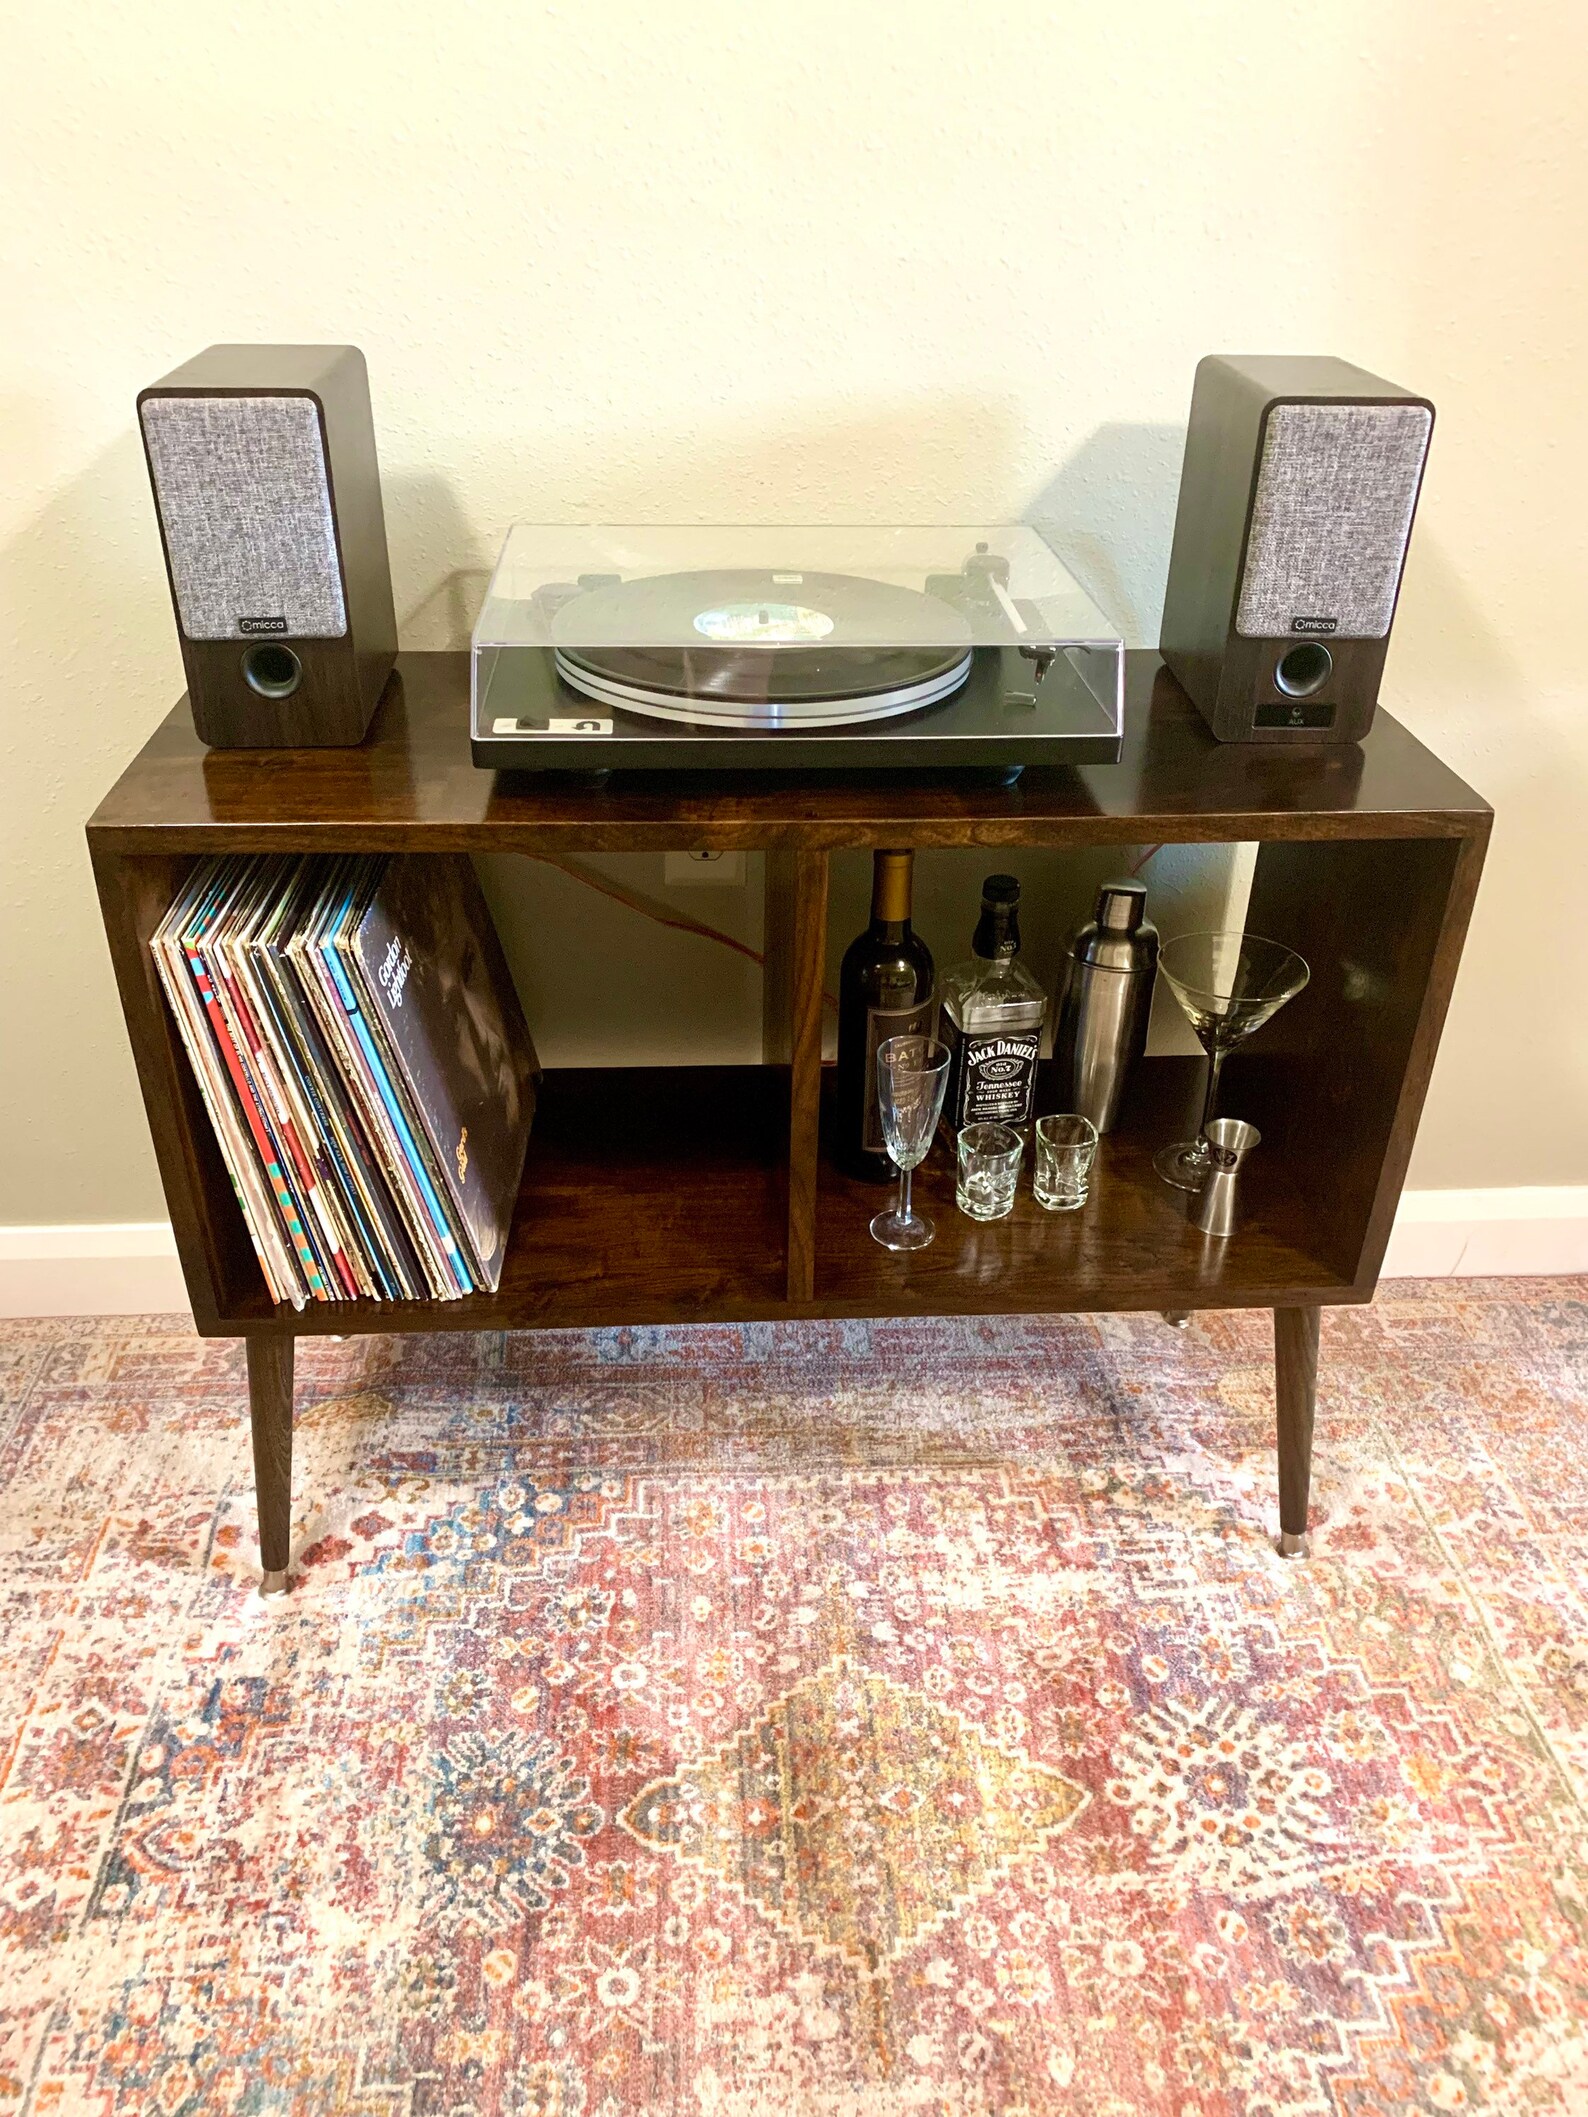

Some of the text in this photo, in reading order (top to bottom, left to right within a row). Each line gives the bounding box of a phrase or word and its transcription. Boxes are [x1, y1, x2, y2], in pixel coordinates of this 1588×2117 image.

[251, 620, 284, 629] micca
[1305, 620, 1335, 630] micca
[378, 935, 402, 987] Gordon
[386, 947, 413, 1010] Lightfoot
[968, 1041, 1037, 1066] JACK DANIEL'S
[976, 1080, 1023, 1091] Tennessee
[976, 1091, 1020, 1101] WHISKEY
